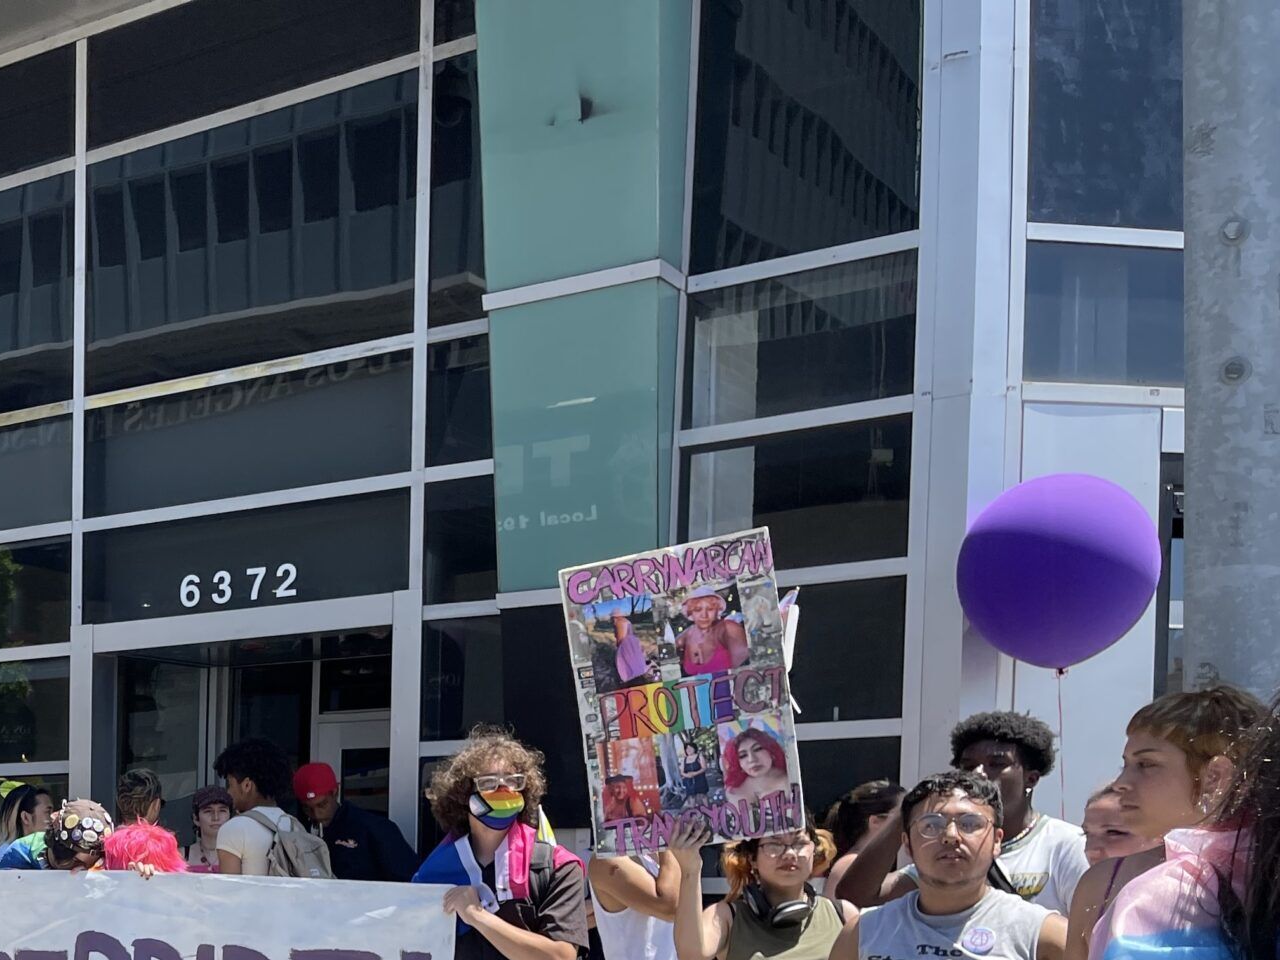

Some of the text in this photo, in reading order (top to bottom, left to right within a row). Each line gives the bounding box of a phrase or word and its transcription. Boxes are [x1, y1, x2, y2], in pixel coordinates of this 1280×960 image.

[180, 563, 297, 608] 6372
[600, 665, 787, 742] PROTECT
[917, 944, 964, 957] The
